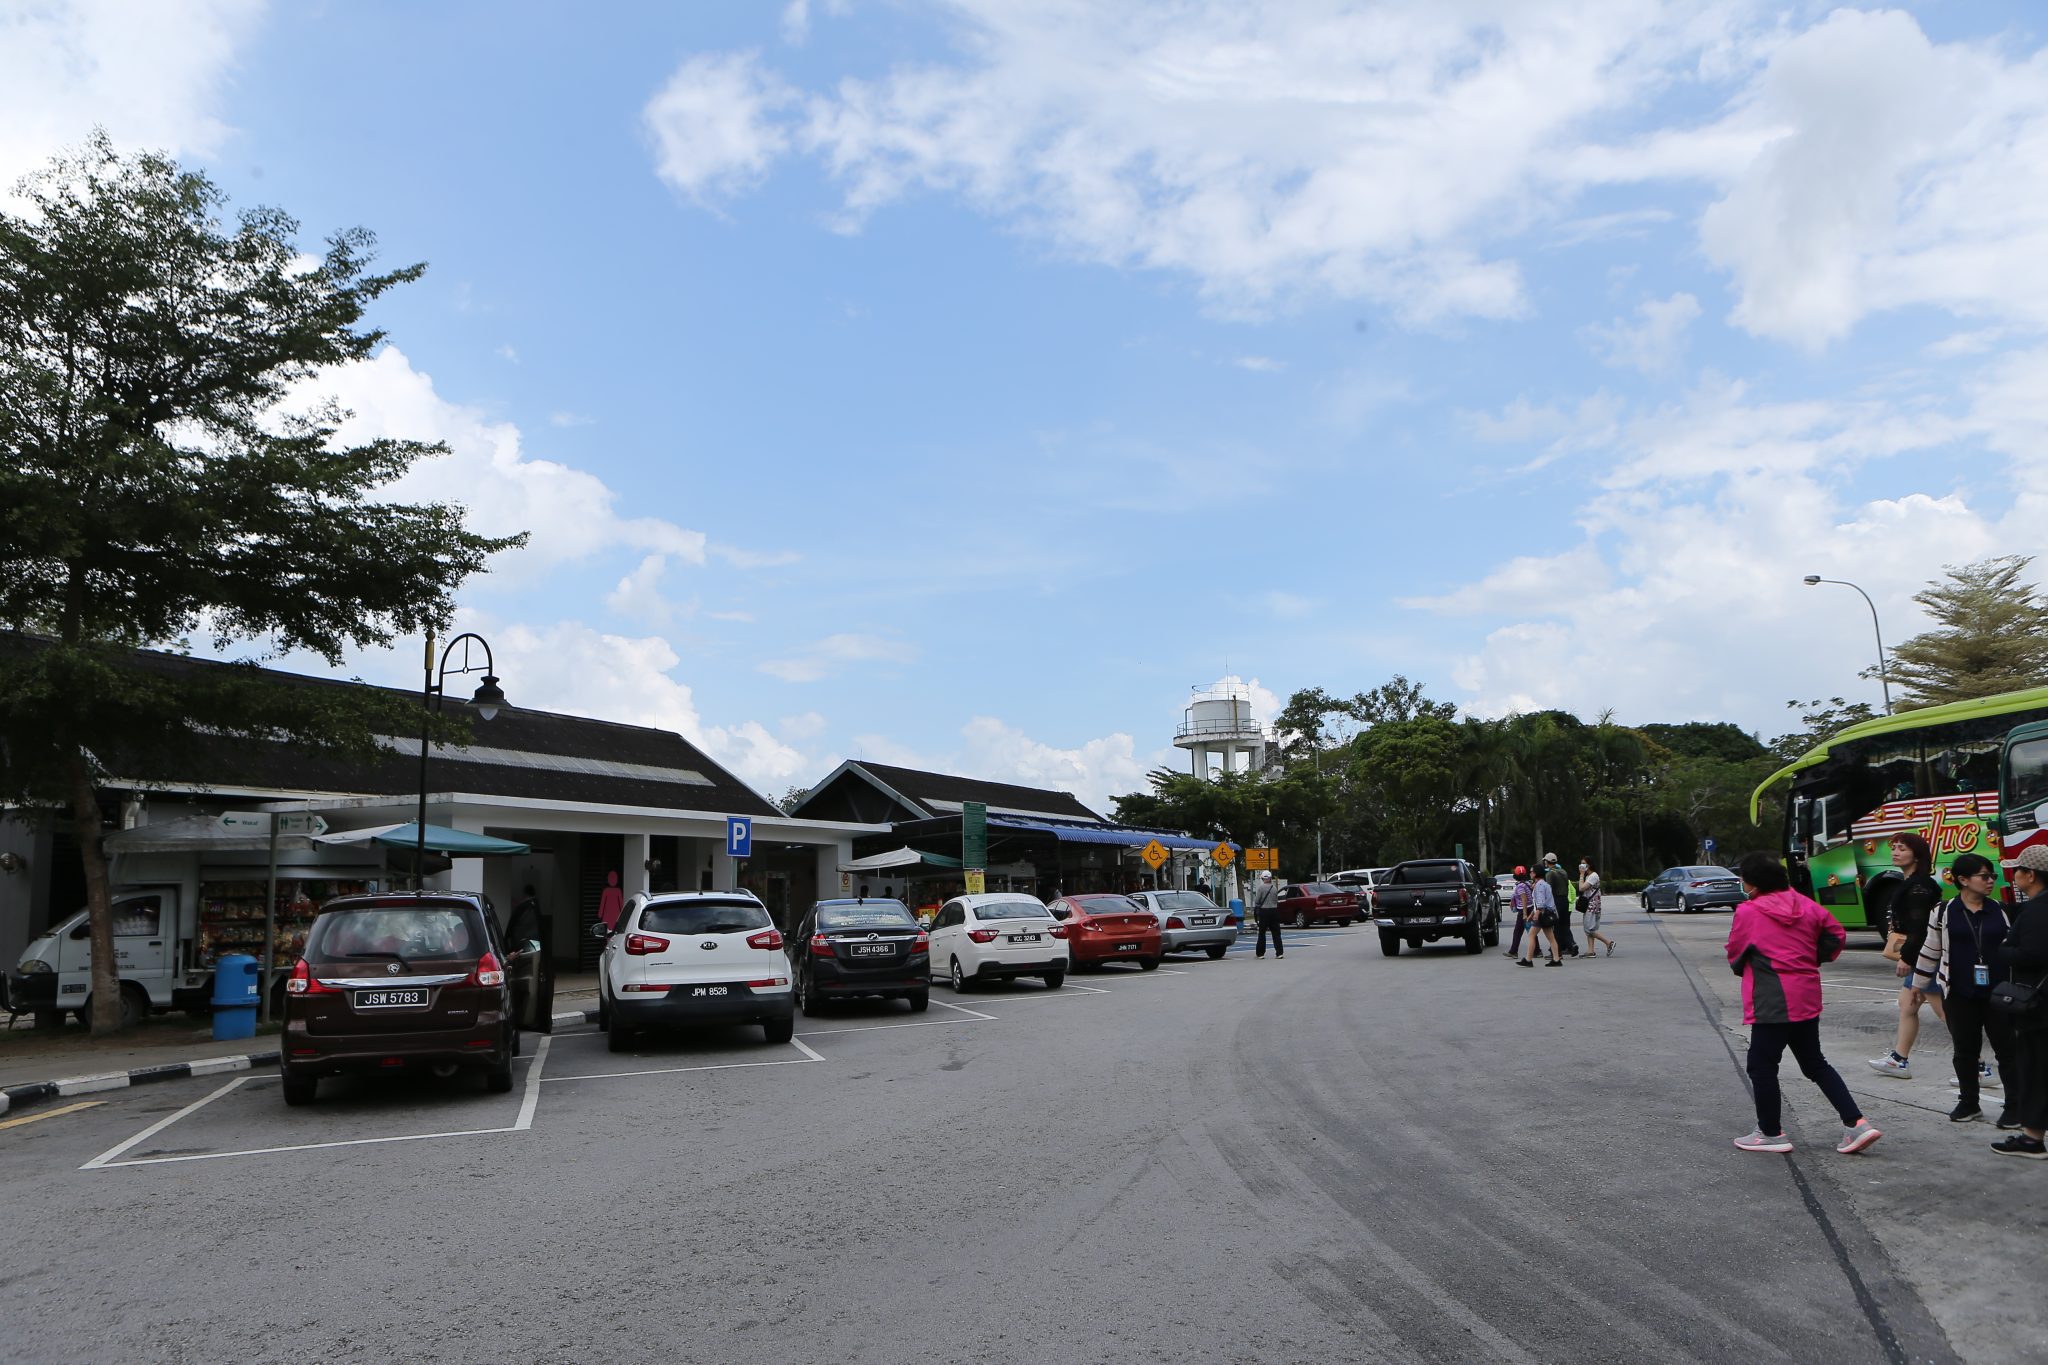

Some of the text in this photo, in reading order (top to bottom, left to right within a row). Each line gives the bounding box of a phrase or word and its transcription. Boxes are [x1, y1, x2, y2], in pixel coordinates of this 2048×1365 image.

[733, 822, 747, 850] P
[1705, 839, 1713, 850] P
[858, 946, 871, 954] JSH
[692, 987, 728, 997] JPM 8528
[365, 993, 419, 1005] JSW 5783
